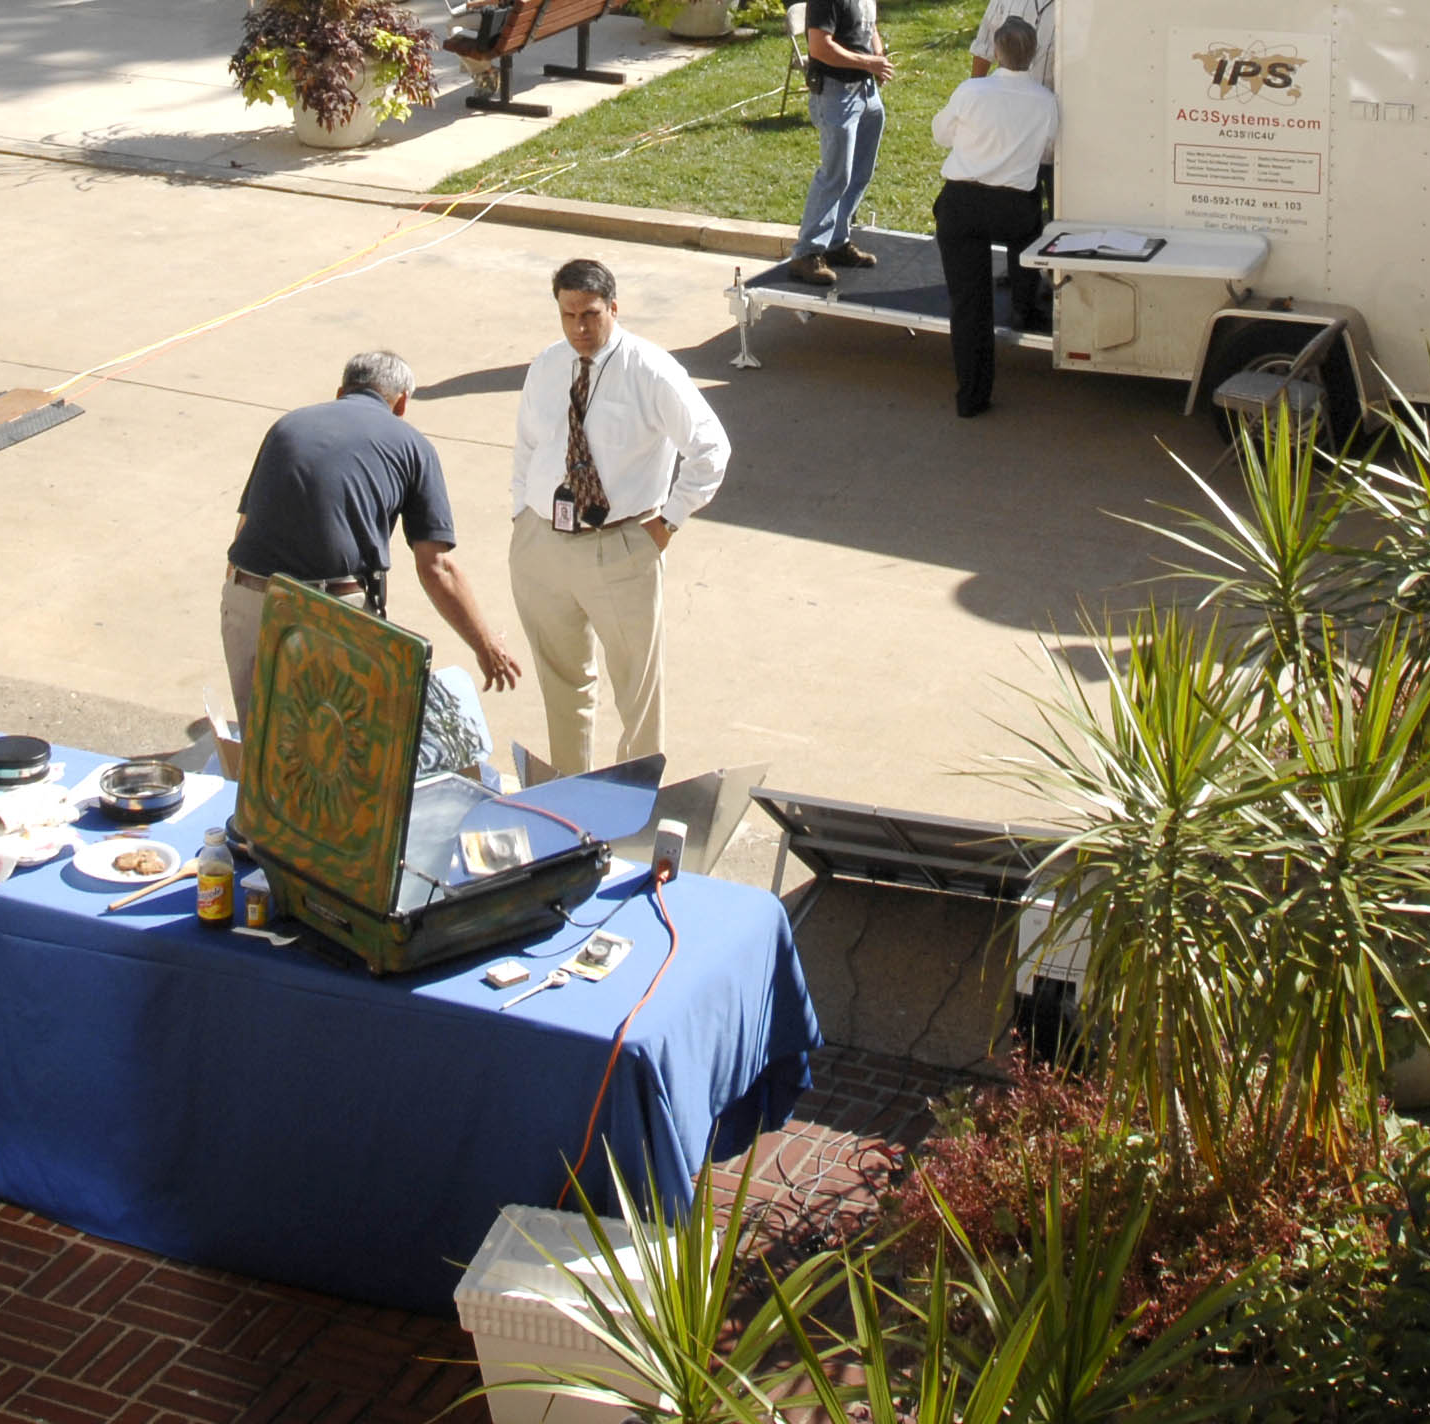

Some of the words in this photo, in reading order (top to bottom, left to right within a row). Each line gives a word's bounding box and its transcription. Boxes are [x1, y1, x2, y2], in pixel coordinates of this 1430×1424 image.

[1212, 59, 1296, 88] IPS
[1176, 108, 1321, 130] AC3Systems.com
[1191, 194, 1256, 207] 650-592-1742
[1285, 201, 1302, 211] 103
